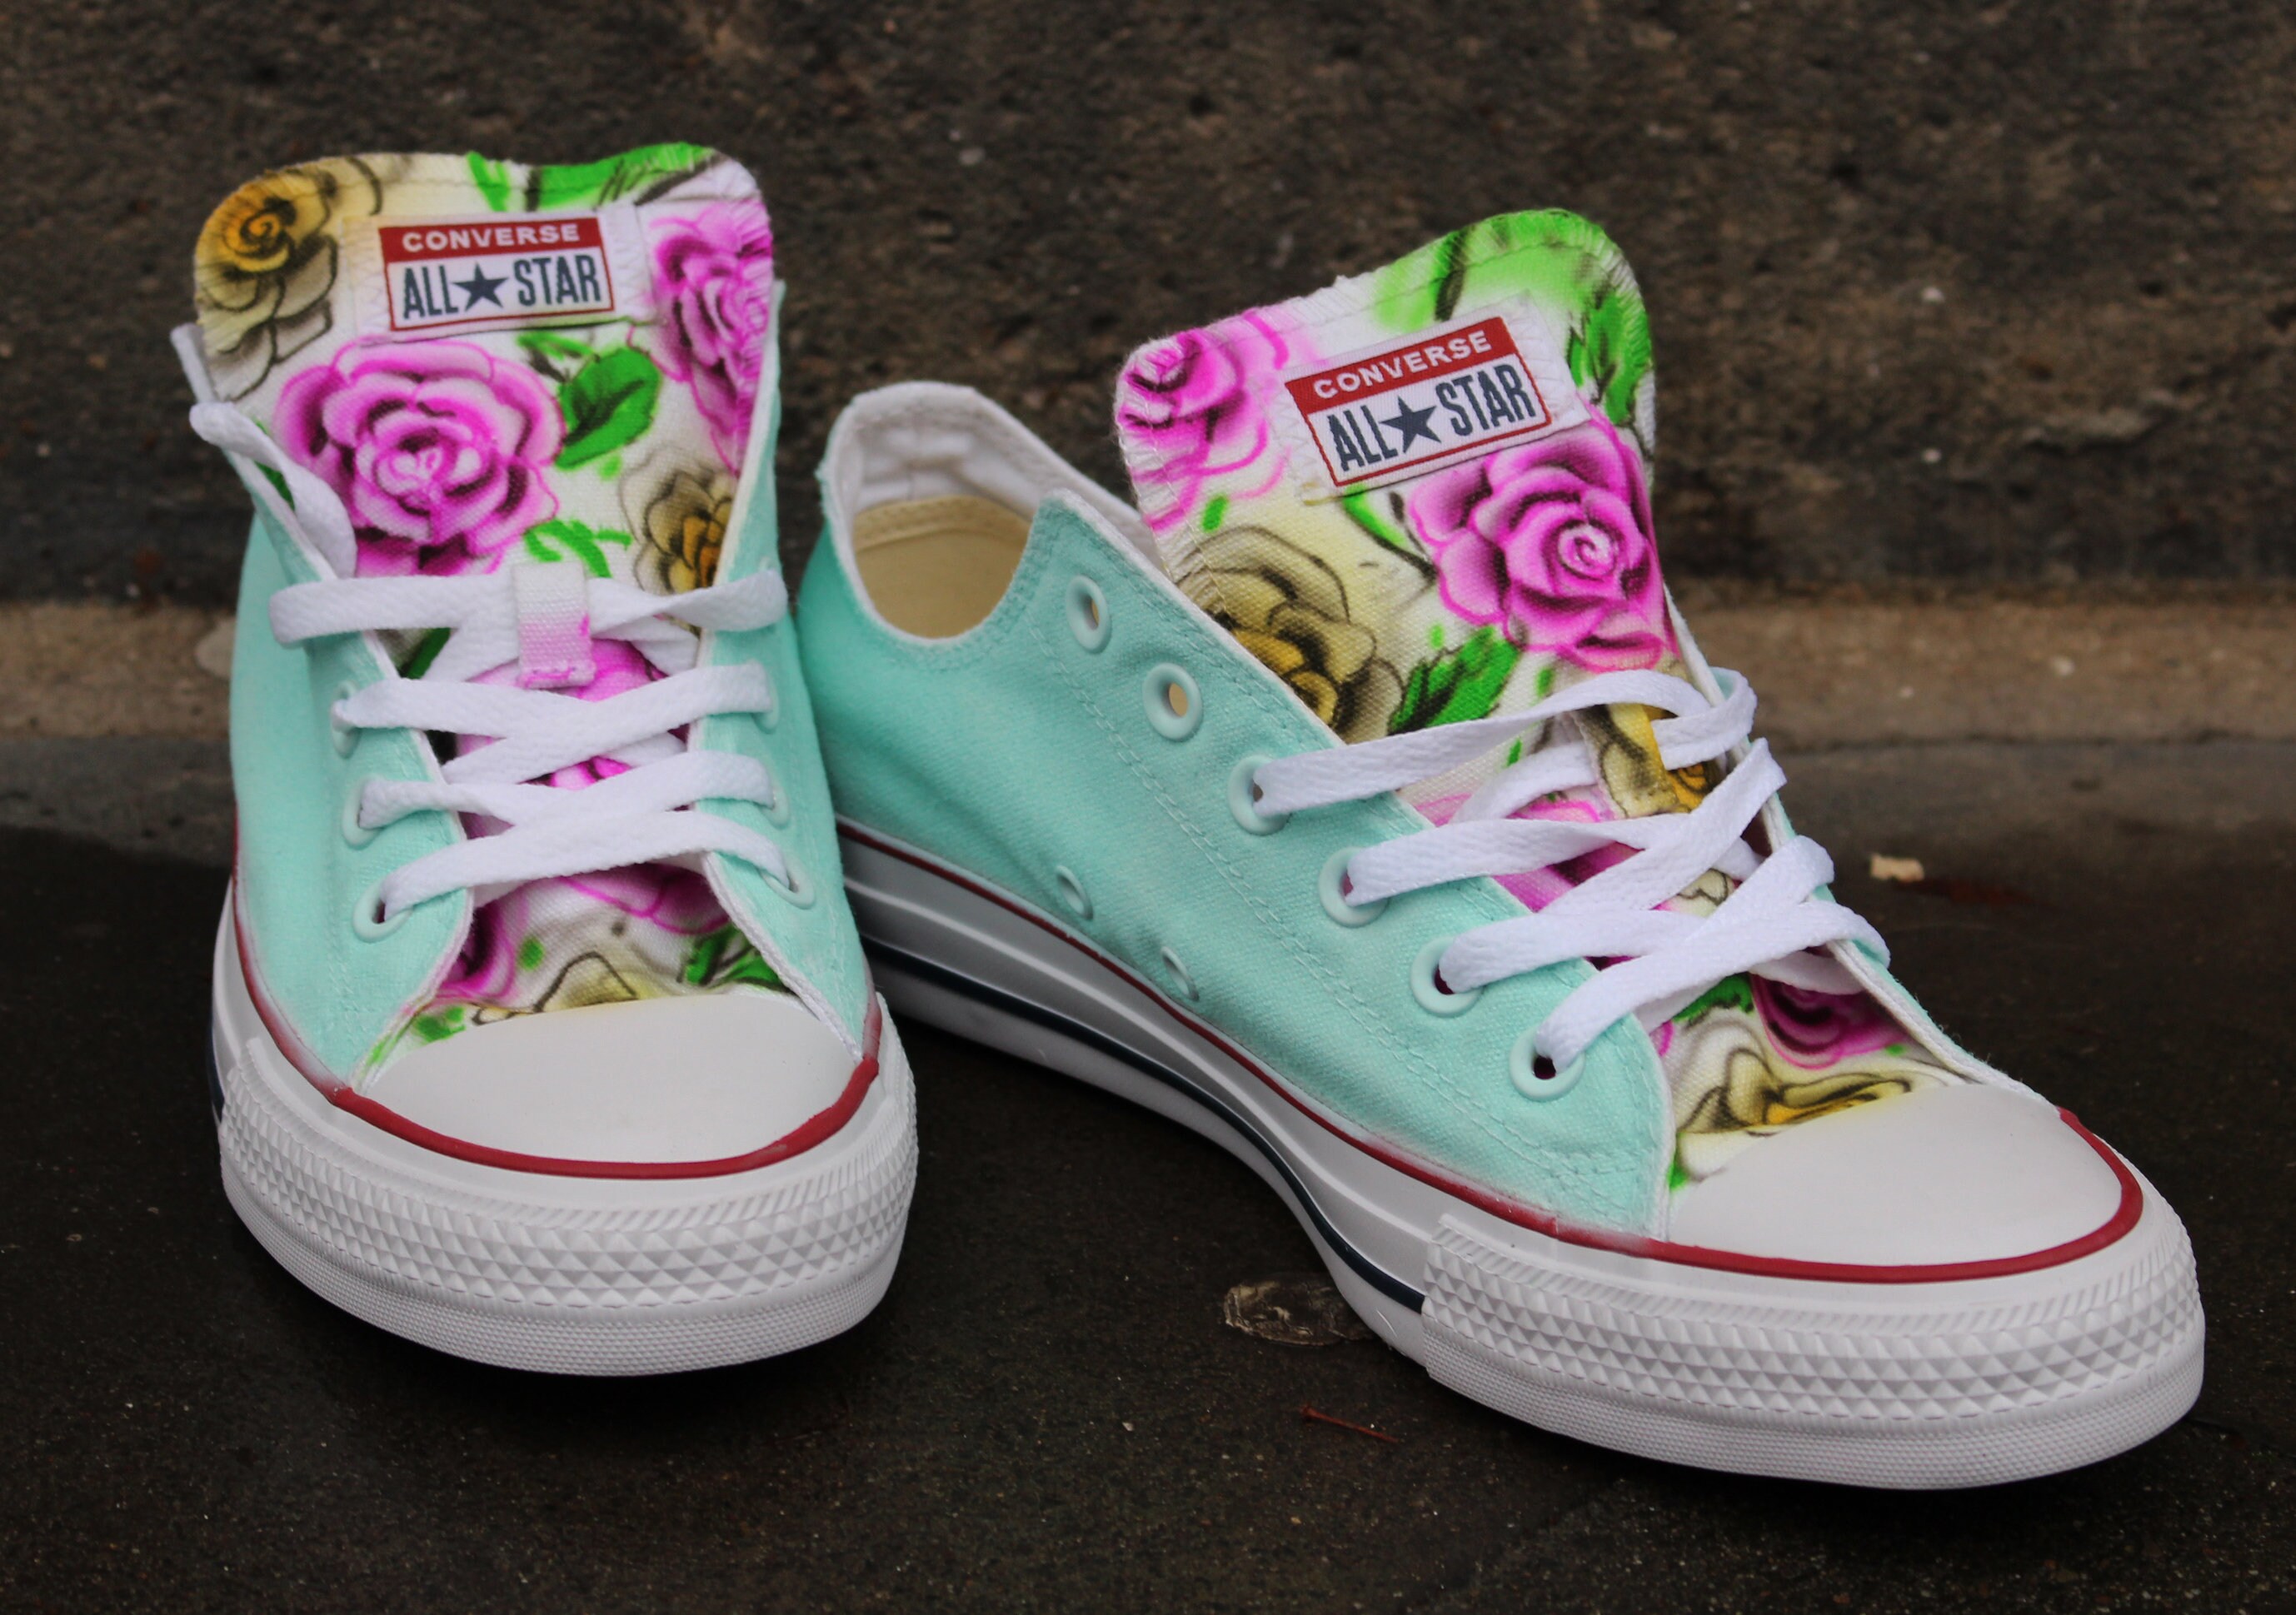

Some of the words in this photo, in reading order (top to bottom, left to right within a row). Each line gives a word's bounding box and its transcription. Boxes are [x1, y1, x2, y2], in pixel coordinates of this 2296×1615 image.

[402, 223, 580, 252] CONVERSE
[403, 264, 459, 319] ALL
[512, 254, 601, 307] STAR
[1313, 330, 1492, 400] CONVERSE
[1326, 405, 1399, 471] ALL
[1435, 363, 1537, 436] STAR
